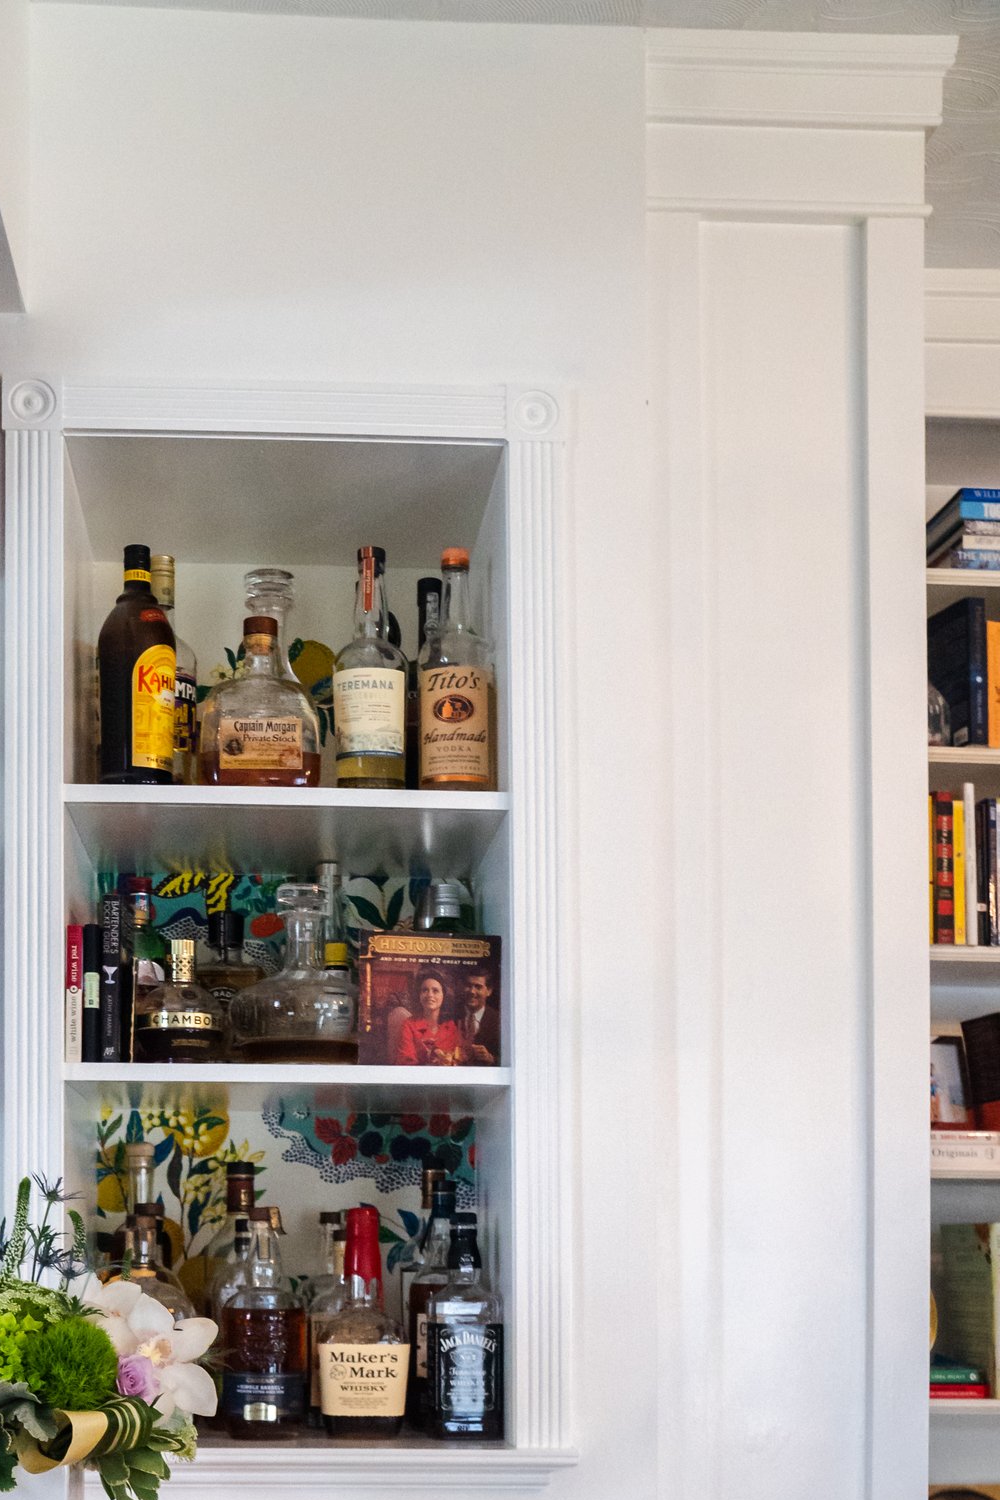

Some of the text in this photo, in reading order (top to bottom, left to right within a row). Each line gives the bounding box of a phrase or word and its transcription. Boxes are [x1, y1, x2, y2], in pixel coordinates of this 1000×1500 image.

[337, 680, 394, 691] TEREMANA
[427, 672, 480, 692] Tito's
[234, 720, 296, 734] Captain Morgan
[243, 734, 297, 742] Private Stock
[423, 727, 487, 745] Handmade
[103, 901, 111, 954] POCKET GUIDE
[111, 901, 120, 954] BARTENDER'S
[380, 939, 443, 952] HISTORY
[71, 945, 79, 982] red wine
[440, 1331, 497, 1352] JACK DANIEL'S
[330, 1351, 398, 1363] Maker's
[349, 1367, 397, 1378] Mark
